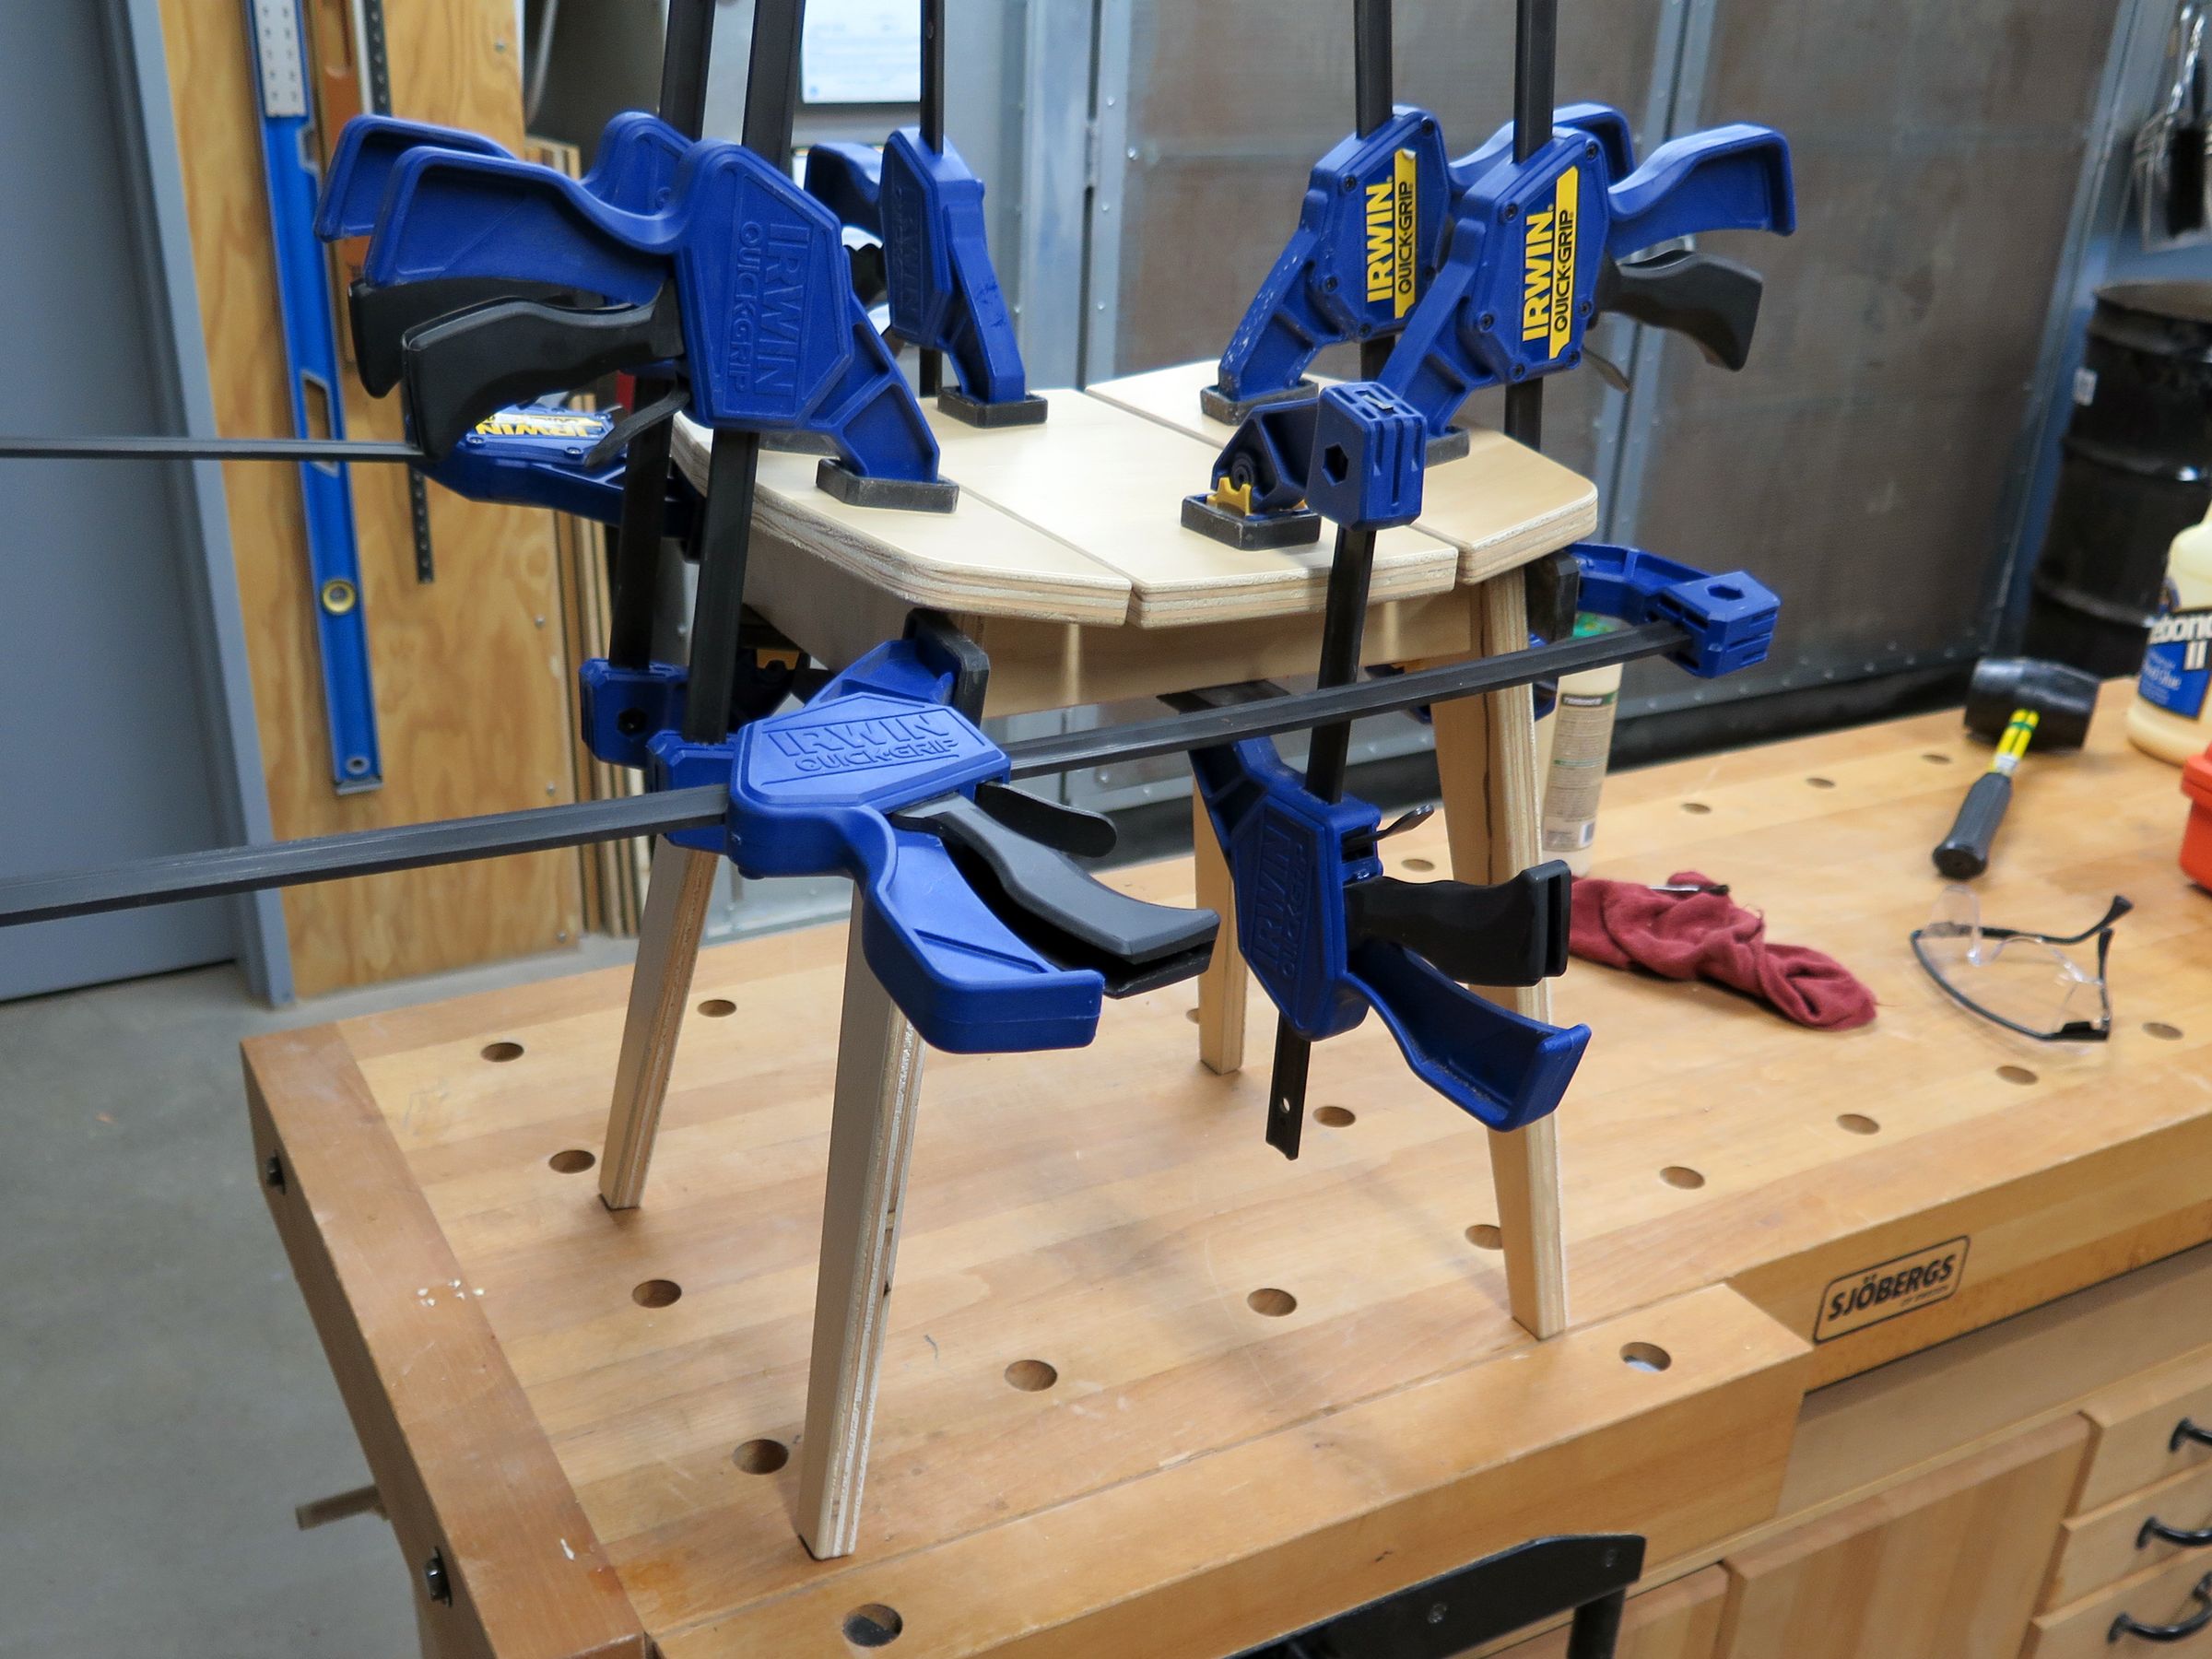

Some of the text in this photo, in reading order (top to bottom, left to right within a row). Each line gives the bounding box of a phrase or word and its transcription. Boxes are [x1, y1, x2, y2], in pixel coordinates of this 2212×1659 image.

[1366, 182, 1393, 302] IRWIN
[1523, 211, 1554, 341] IRWIN
[754, 224, 810, 396] IRWIN
[476, 423, 588, 438] IRWIN
[2149, 613, 2212, 644] ebon
[768, 714, 949, 757] IRWIN
[1828, 1254, 1956, 1321] SJÖBERGS
